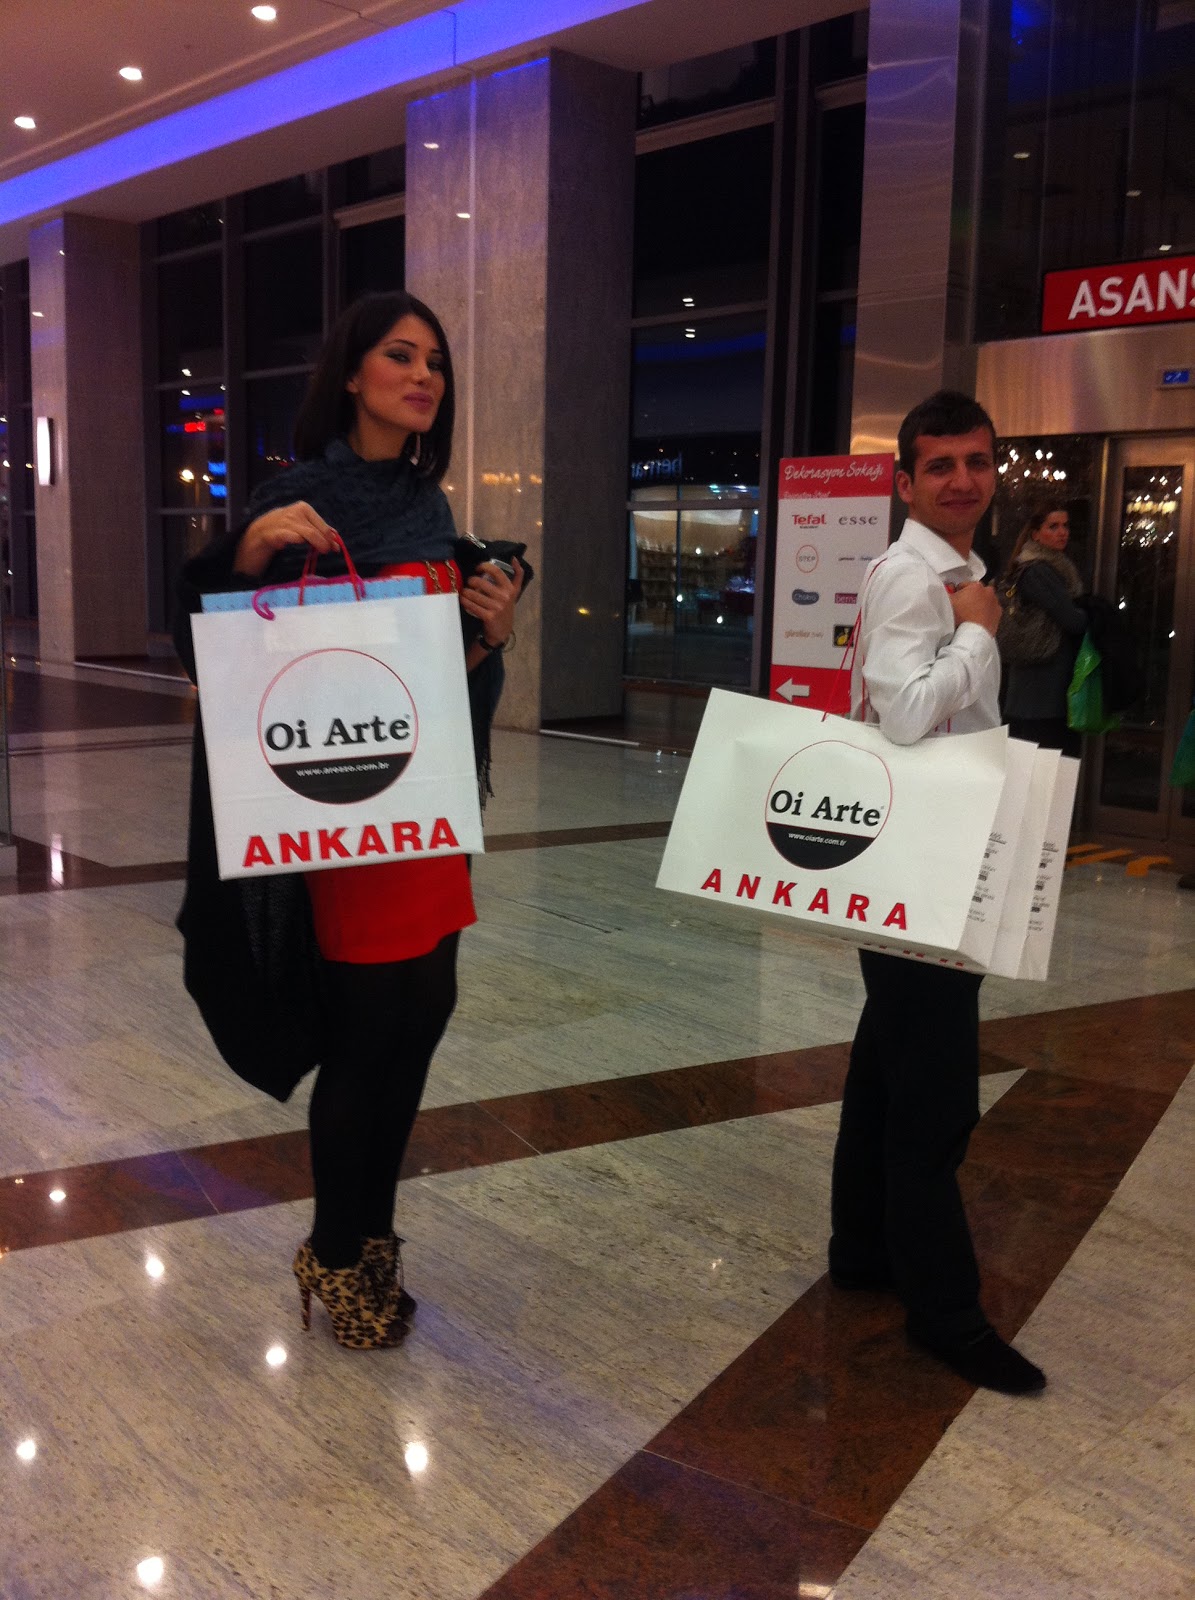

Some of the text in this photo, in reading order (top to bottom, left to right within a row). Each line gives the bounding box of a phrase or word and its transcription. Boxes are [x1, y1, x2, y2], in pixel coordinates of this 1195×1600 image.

[1067, 268, 1195, 321] ASAN
[784, 465, 845, 484] Dekorasyon
[792, 513, 827, 526] Tefal
[838, 515, 878, 526] esse
[265, 714, 411, 752] Oi Arte
[770, 789, 880, 827] Oi Arte
[242, 817, 461, 868] ANKARA
[701, 867, 909, 931] ANKARA
